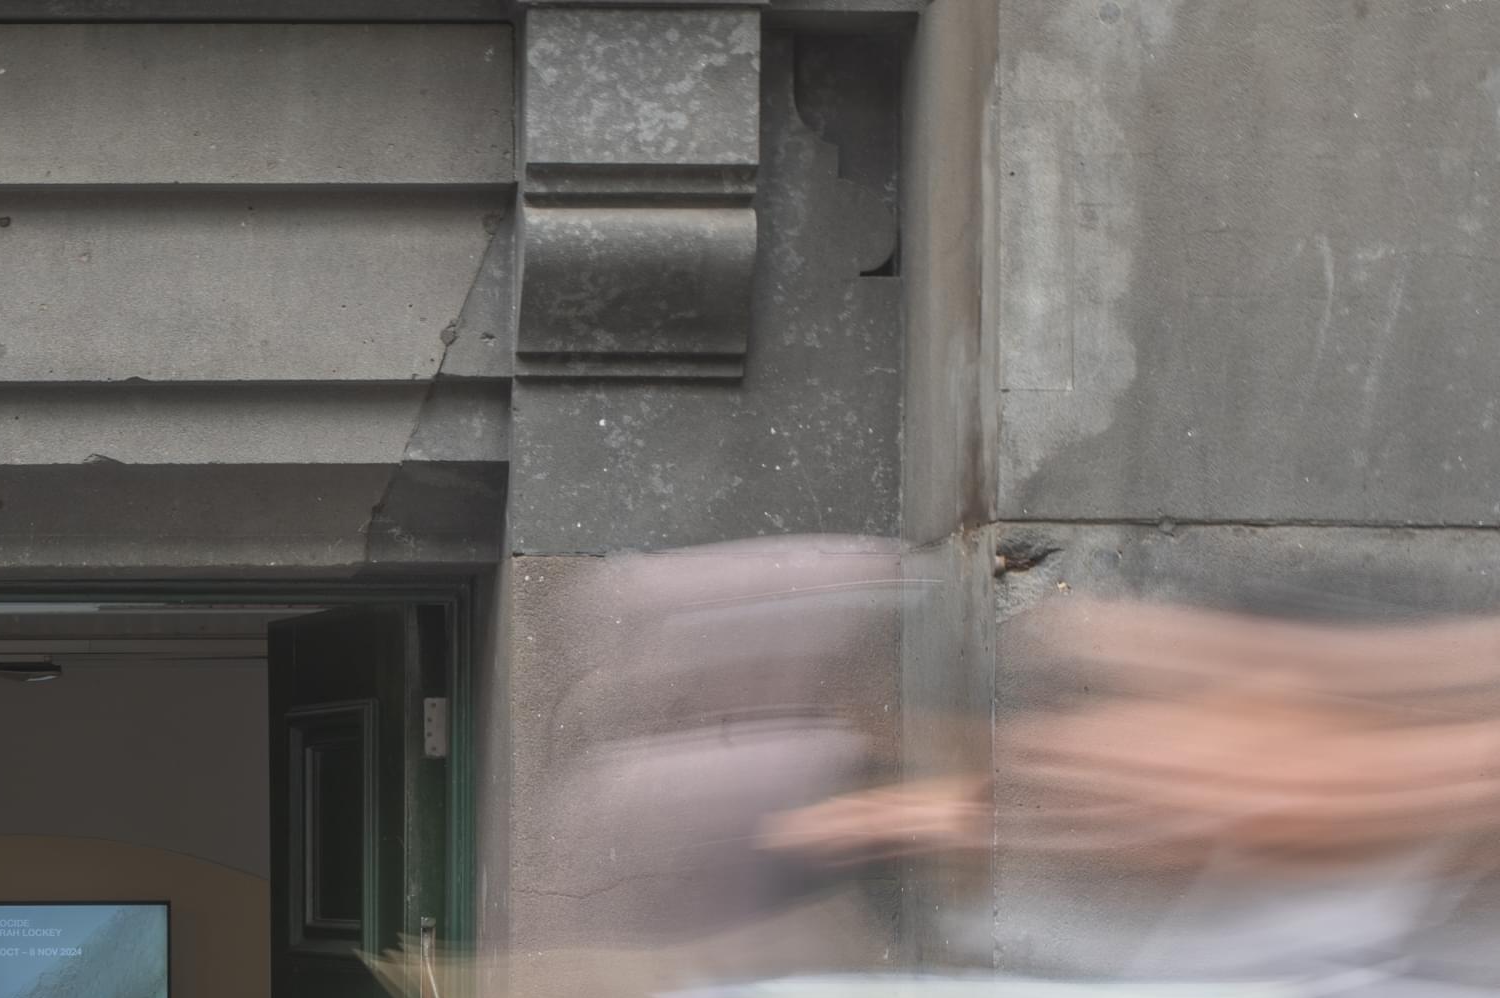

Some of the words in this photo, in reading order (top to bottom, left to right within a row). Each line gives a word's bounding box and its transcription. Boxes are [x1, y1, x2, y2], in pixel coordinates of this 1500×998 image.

[21, 928, 62, 937] LOCKEY
[0, 947, 20, 957] OCT
[37, 947, 59, 957] NOV
[60, 947, 83, 957] 2024
